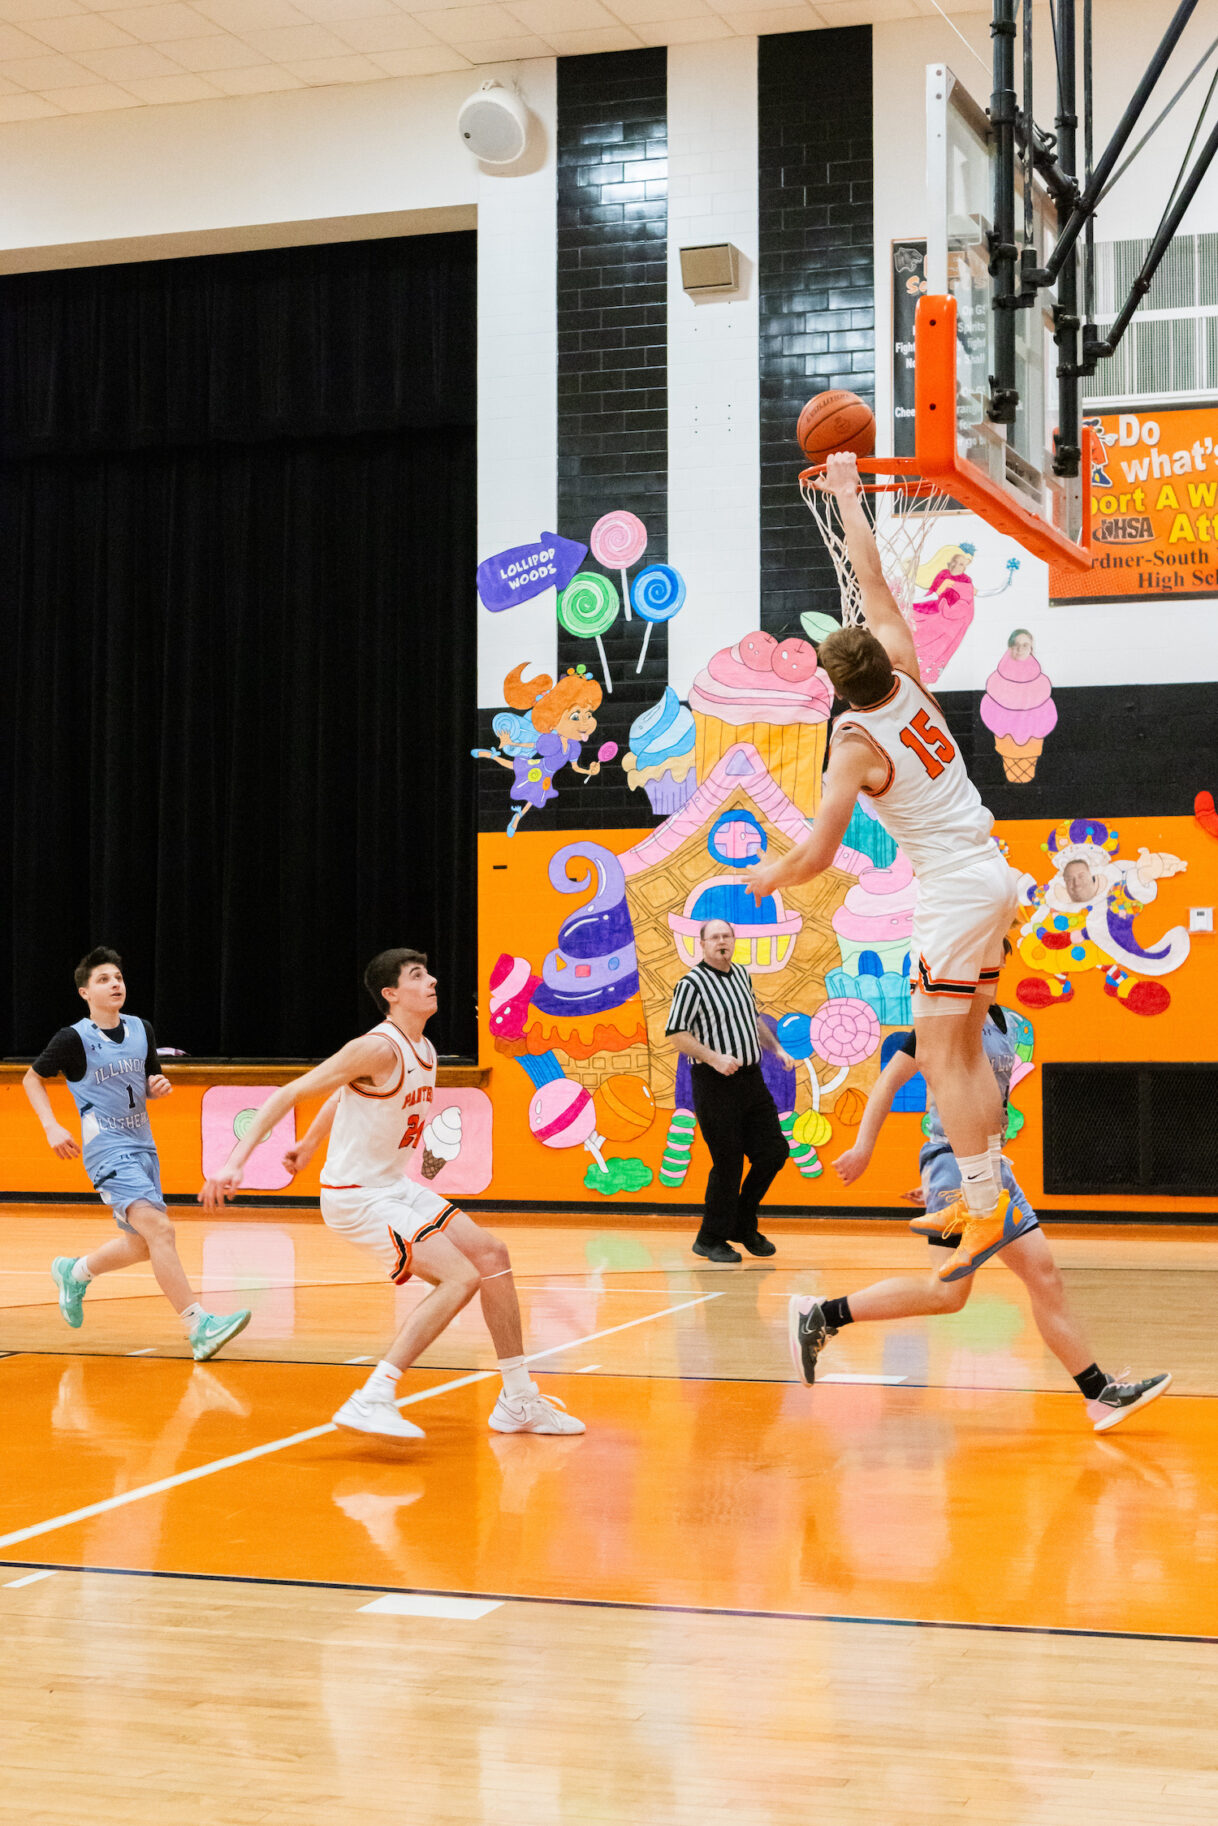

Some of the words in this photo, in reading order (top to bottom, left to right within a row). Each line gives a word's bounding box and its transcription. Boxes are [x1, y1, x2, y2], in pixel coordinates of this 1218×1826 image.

[1118, 414, 1160, 447] Do
[1155, 484, 1179, 511] A
[1187, 482, 1218, 509] W
[500, 548, 555, 580] LOLLIPOP
[508, 563, 557, 590] WOODS
[1139, 571, 1184, 592] High
[1192, 569, 1218, 586] Sc
[899, 707, 956, 781] 15
[126, 1083, 136, 1109] 1
